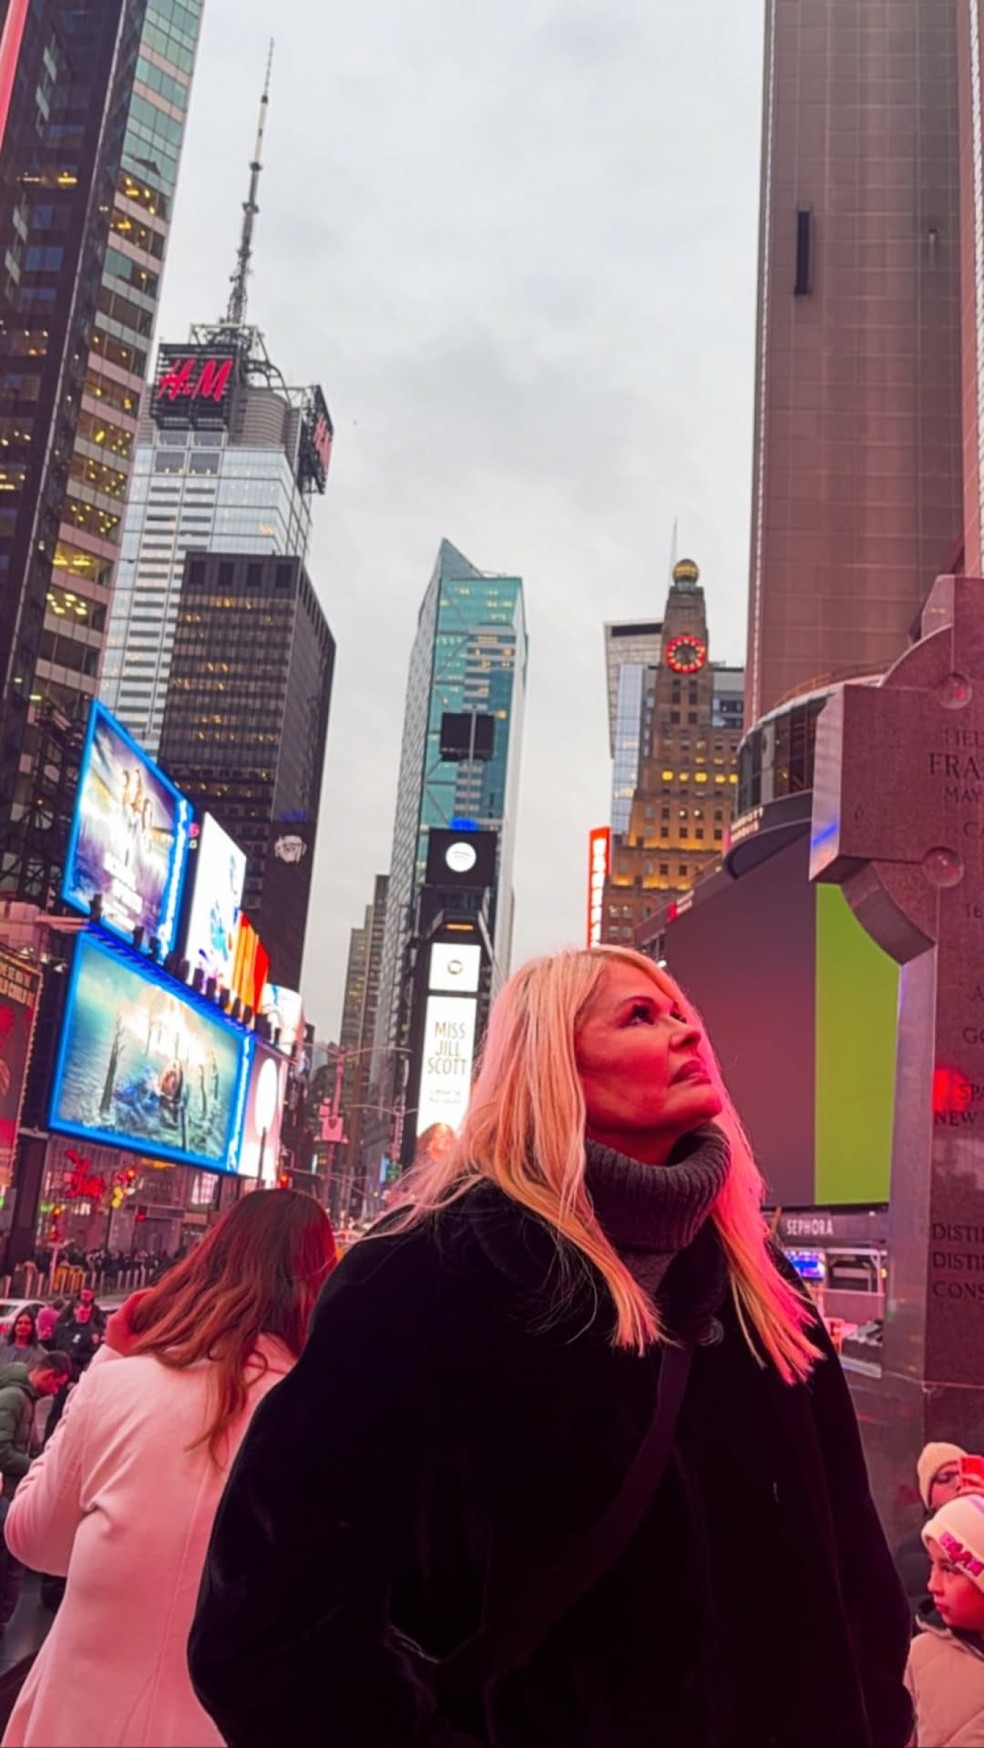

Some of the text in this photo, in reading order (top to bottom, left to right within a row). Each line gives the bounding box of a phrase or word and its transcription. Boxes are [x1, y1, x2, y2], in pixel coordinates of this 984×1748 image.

[155, 357, 233, 402] H&M
[944, 786, 983, 804] MAY
[434, 1022, 466, 1040] MISS
[435, 1039, 460, 1057] JILL
[427, 1056, 467, 1076] SCOTT
[933, 1108, 977, 1127] NEW
[786, 1218, 834, 1237] SEPHORA
[932, 1223, 984, 1244] DISTI
[932, 1251, 984, 1272] DISTI
